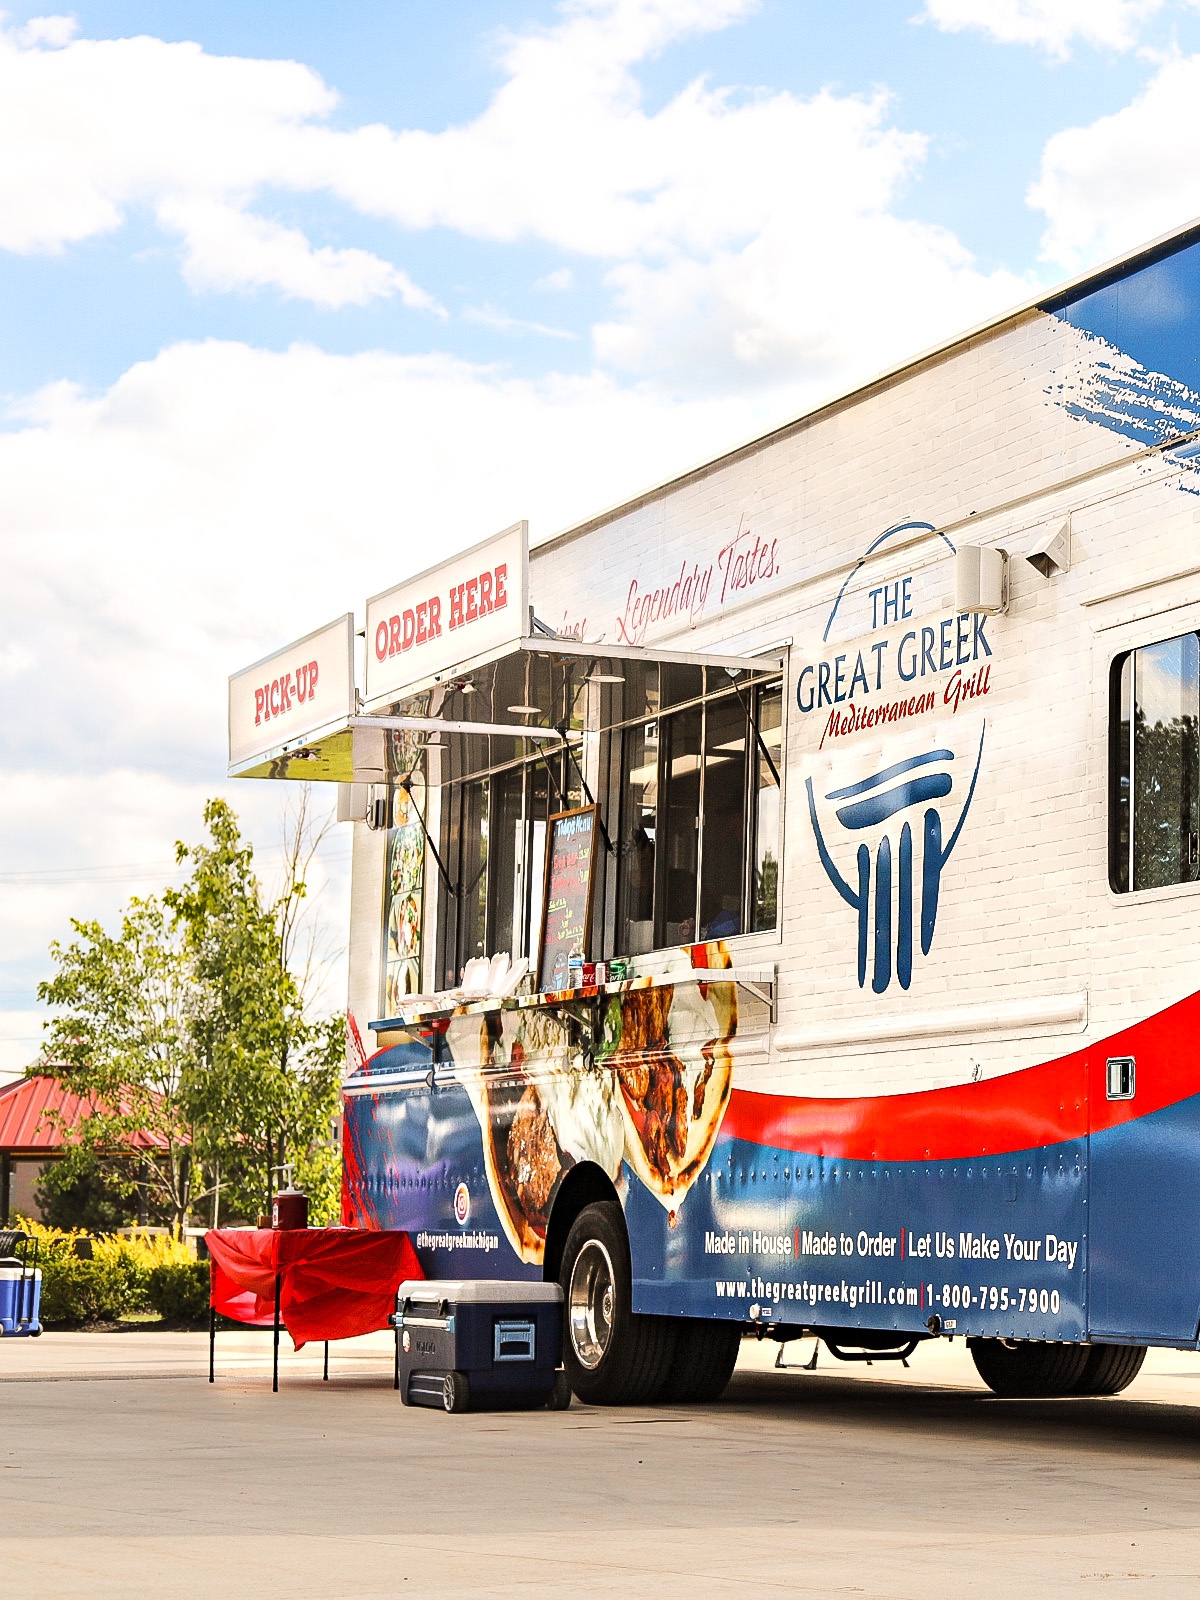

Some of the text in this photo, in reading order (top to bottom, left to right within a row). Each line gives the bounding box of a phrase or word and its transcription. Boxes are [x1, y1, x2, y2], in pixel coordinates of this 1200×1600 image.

[615, 512, 780, 645] Legendary Tastes.
[868, 576, 913, 629] THE
[376, 596, 442, 663] ORDER
[449, 563, 507, 632] HERE
[254, 660, 319, 727] PICK-UP
[796, 613, 992, 713] GREAT GREEK
[819, 664, 992, 750] Mediterranean Grill
[416, 1230, 499, 1252] @thegreatgreekmichigan
[704, 1231, 1079, 1270] Made in House Made to Order Let Us Make Your Day
[715, 1277, 1060, 1315] www.thegreatgreekgrill.com 1-800-795-7900
